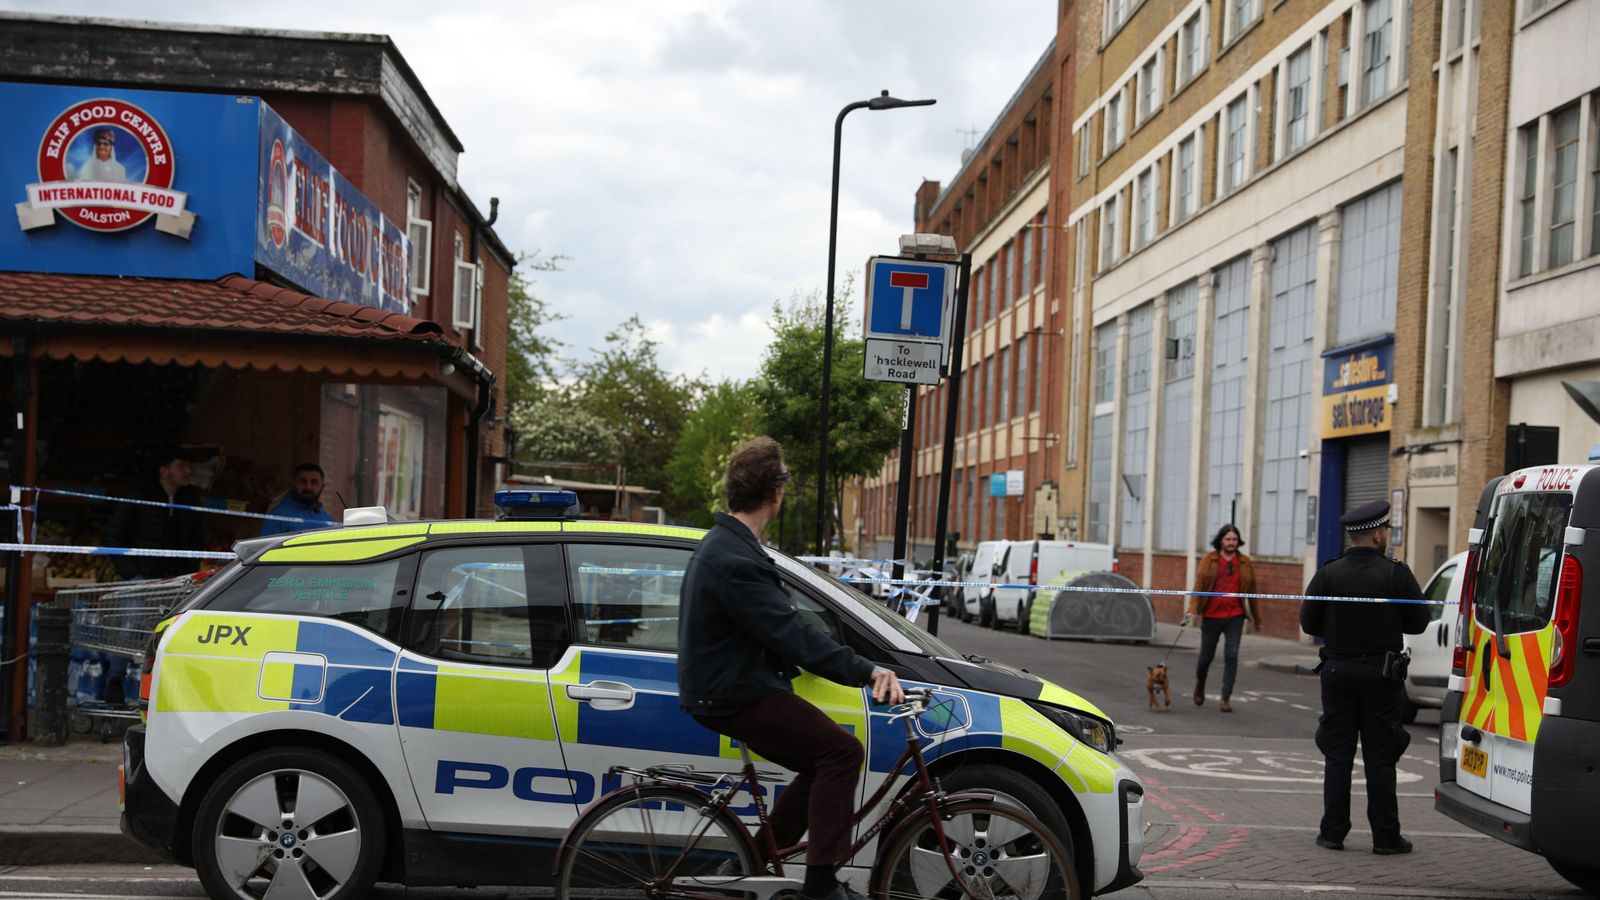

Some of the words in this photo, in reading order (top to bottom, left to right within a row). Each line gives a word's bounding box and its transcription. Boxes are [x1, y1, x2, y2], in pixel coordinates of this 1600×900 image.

[46, 122, 71, 159] ELIF
[69, 105, 117, 127] FOOD
[120, 110, 167, 165] CENTRE
[38, 187, 137, 203] INTERNATIONAL
[141, 192, 175, 208] FOOD
[79, 208, 131, 224] DALSTON
[898, 345, 910, 355] To
[873, 355, 936, 369] hacklewell
[888, 368, 916, 379] Road
[1536, 468, 1579, 491] POLICE
[268, 578, 306, 588] ZERO
[309, 578, 376, 589] EMISSION
[290, 589, 350, 600] VEHICLE
[197, 625, 252, 646] JPX
[435, 760, 788, 818] POLC
